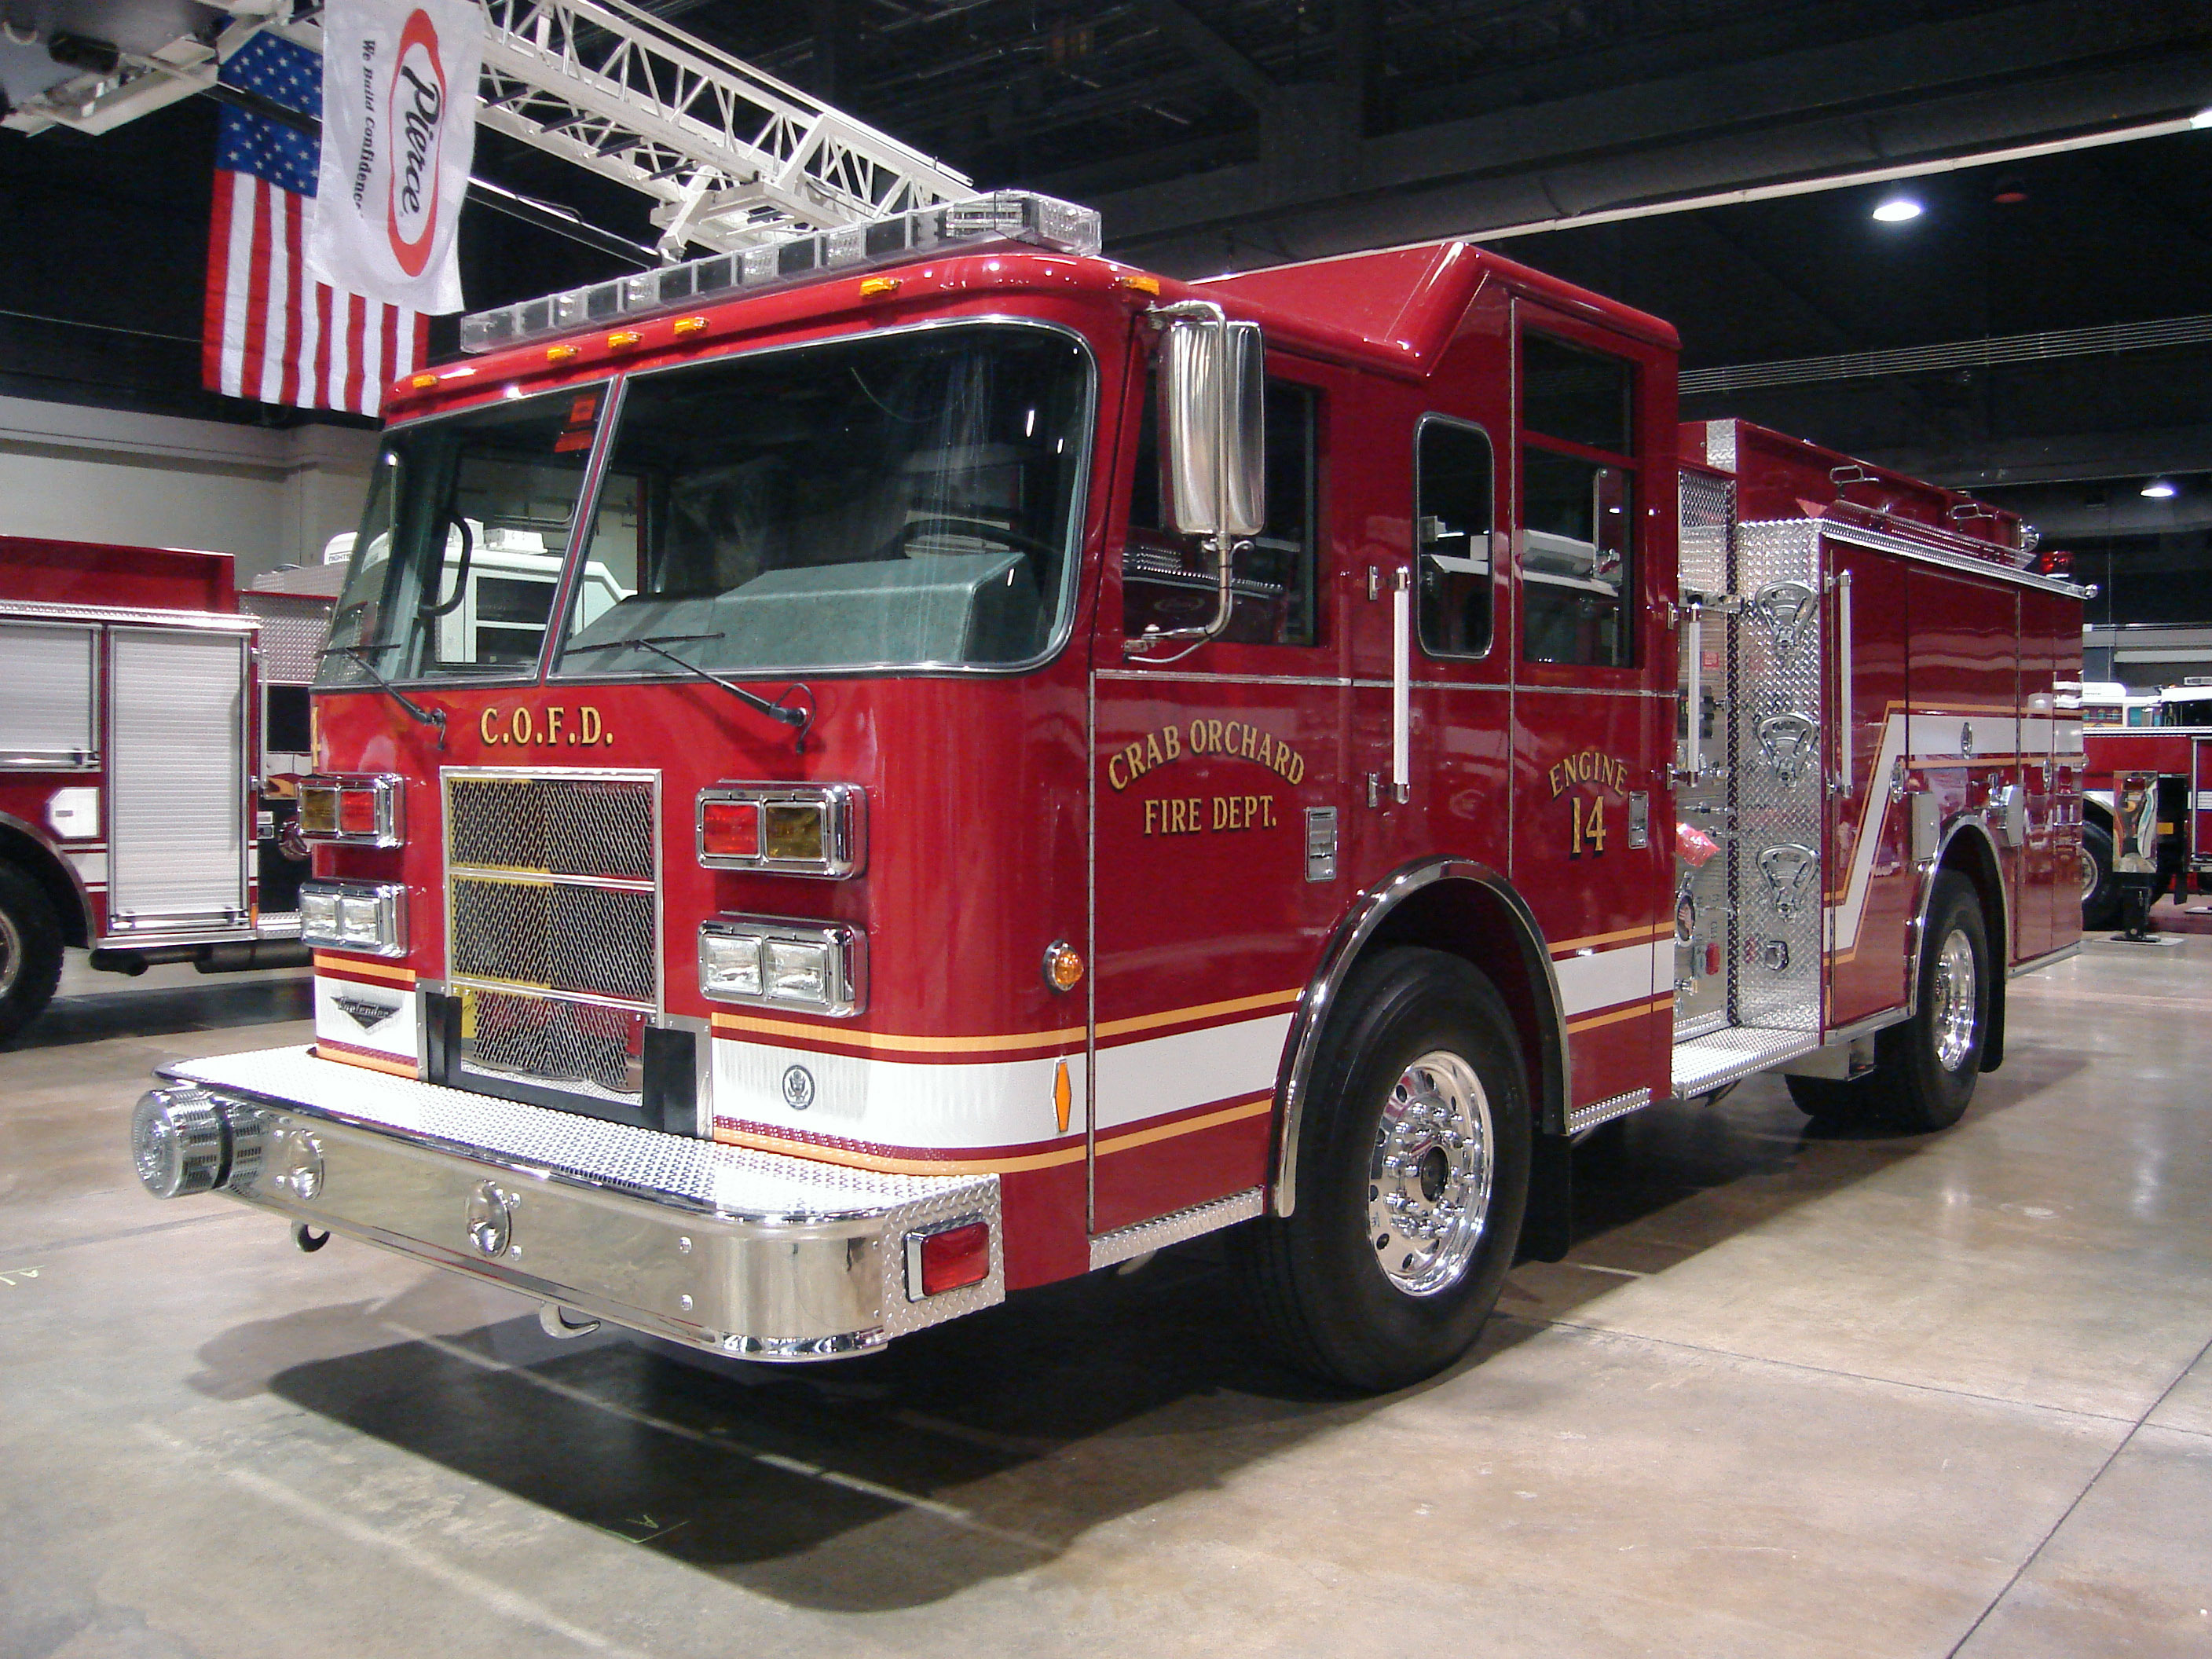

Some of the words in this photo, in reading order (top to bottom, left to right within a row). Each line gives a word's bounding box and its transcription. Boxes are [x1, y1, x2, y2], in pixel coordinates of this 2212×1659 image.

[362, 39, 375, 61] We
[362, 66, 375, 112] Build
[401, 65, 441, 214] Pierce
[480, 706, 614, 745] C.O.F.D.
[1108, 724, 1181, 790] CRAB
[1188, 719, 1305, 786] ORCHARD
[1548, 751, 1628, 799] ENGINE
[1143, 798, 1202, 835] FIRE
[1211, 795, 1277, 830] DEPT.
[1571, 795, 1606, 854] 14
